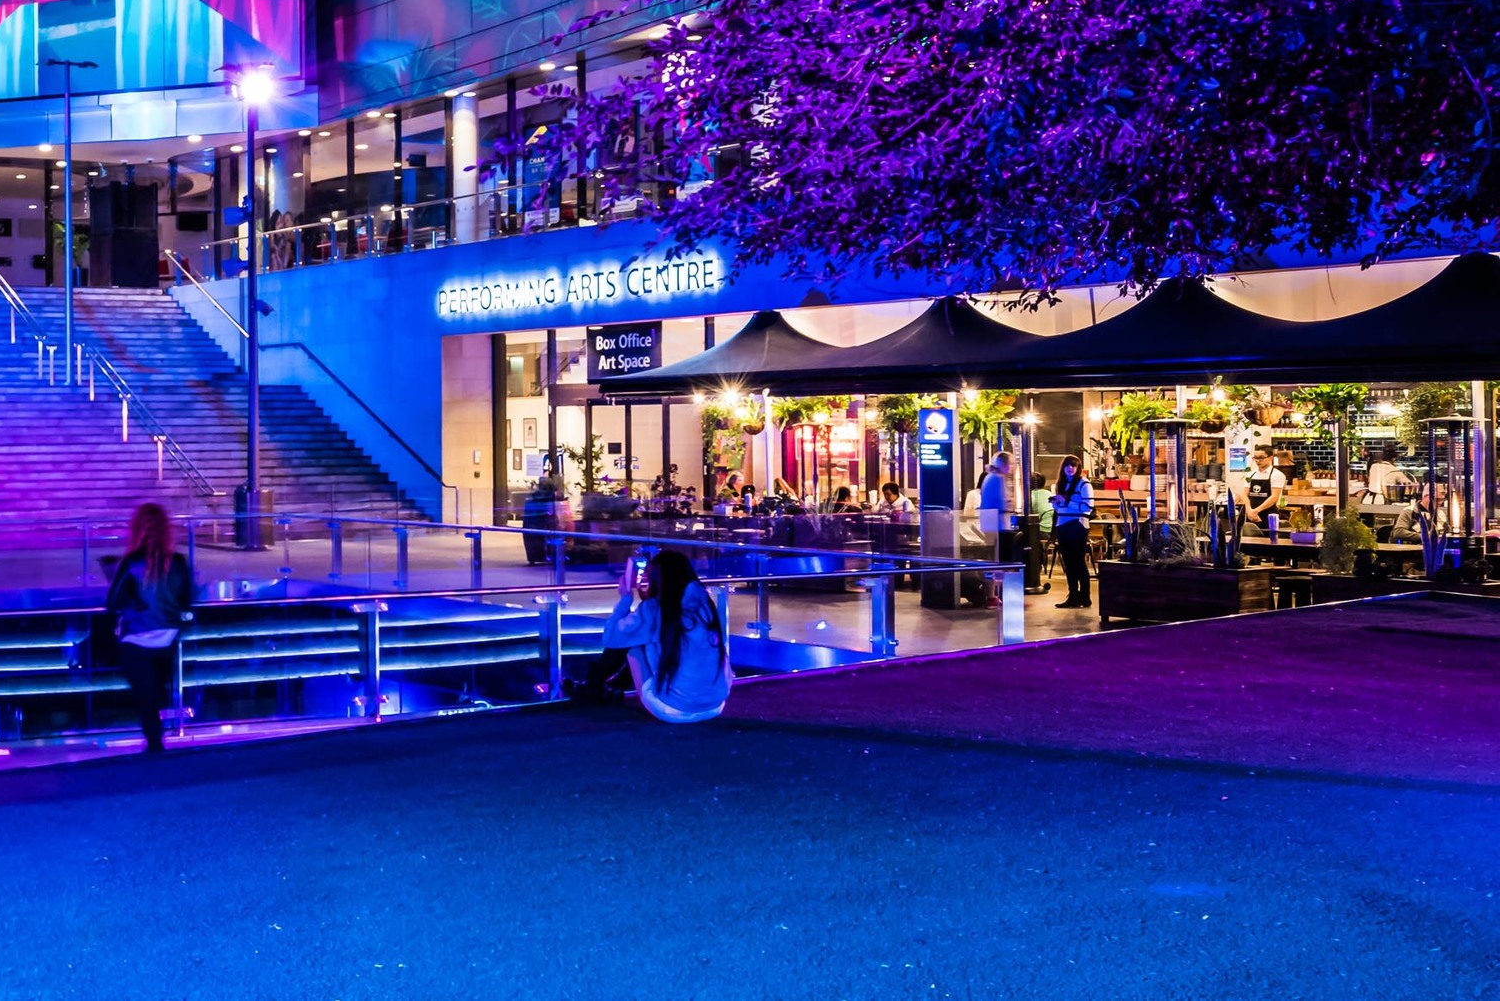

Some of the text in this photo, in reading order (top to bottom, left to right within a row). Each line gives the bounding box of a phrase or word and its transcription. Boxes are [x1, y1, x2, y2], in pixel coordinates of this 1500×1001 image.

[438, 259, 716, 315] PERFORMING ARTS CENTRE
[596, 333, 652, 350] Box Office
[598, 354, 651, 372] Art Space
